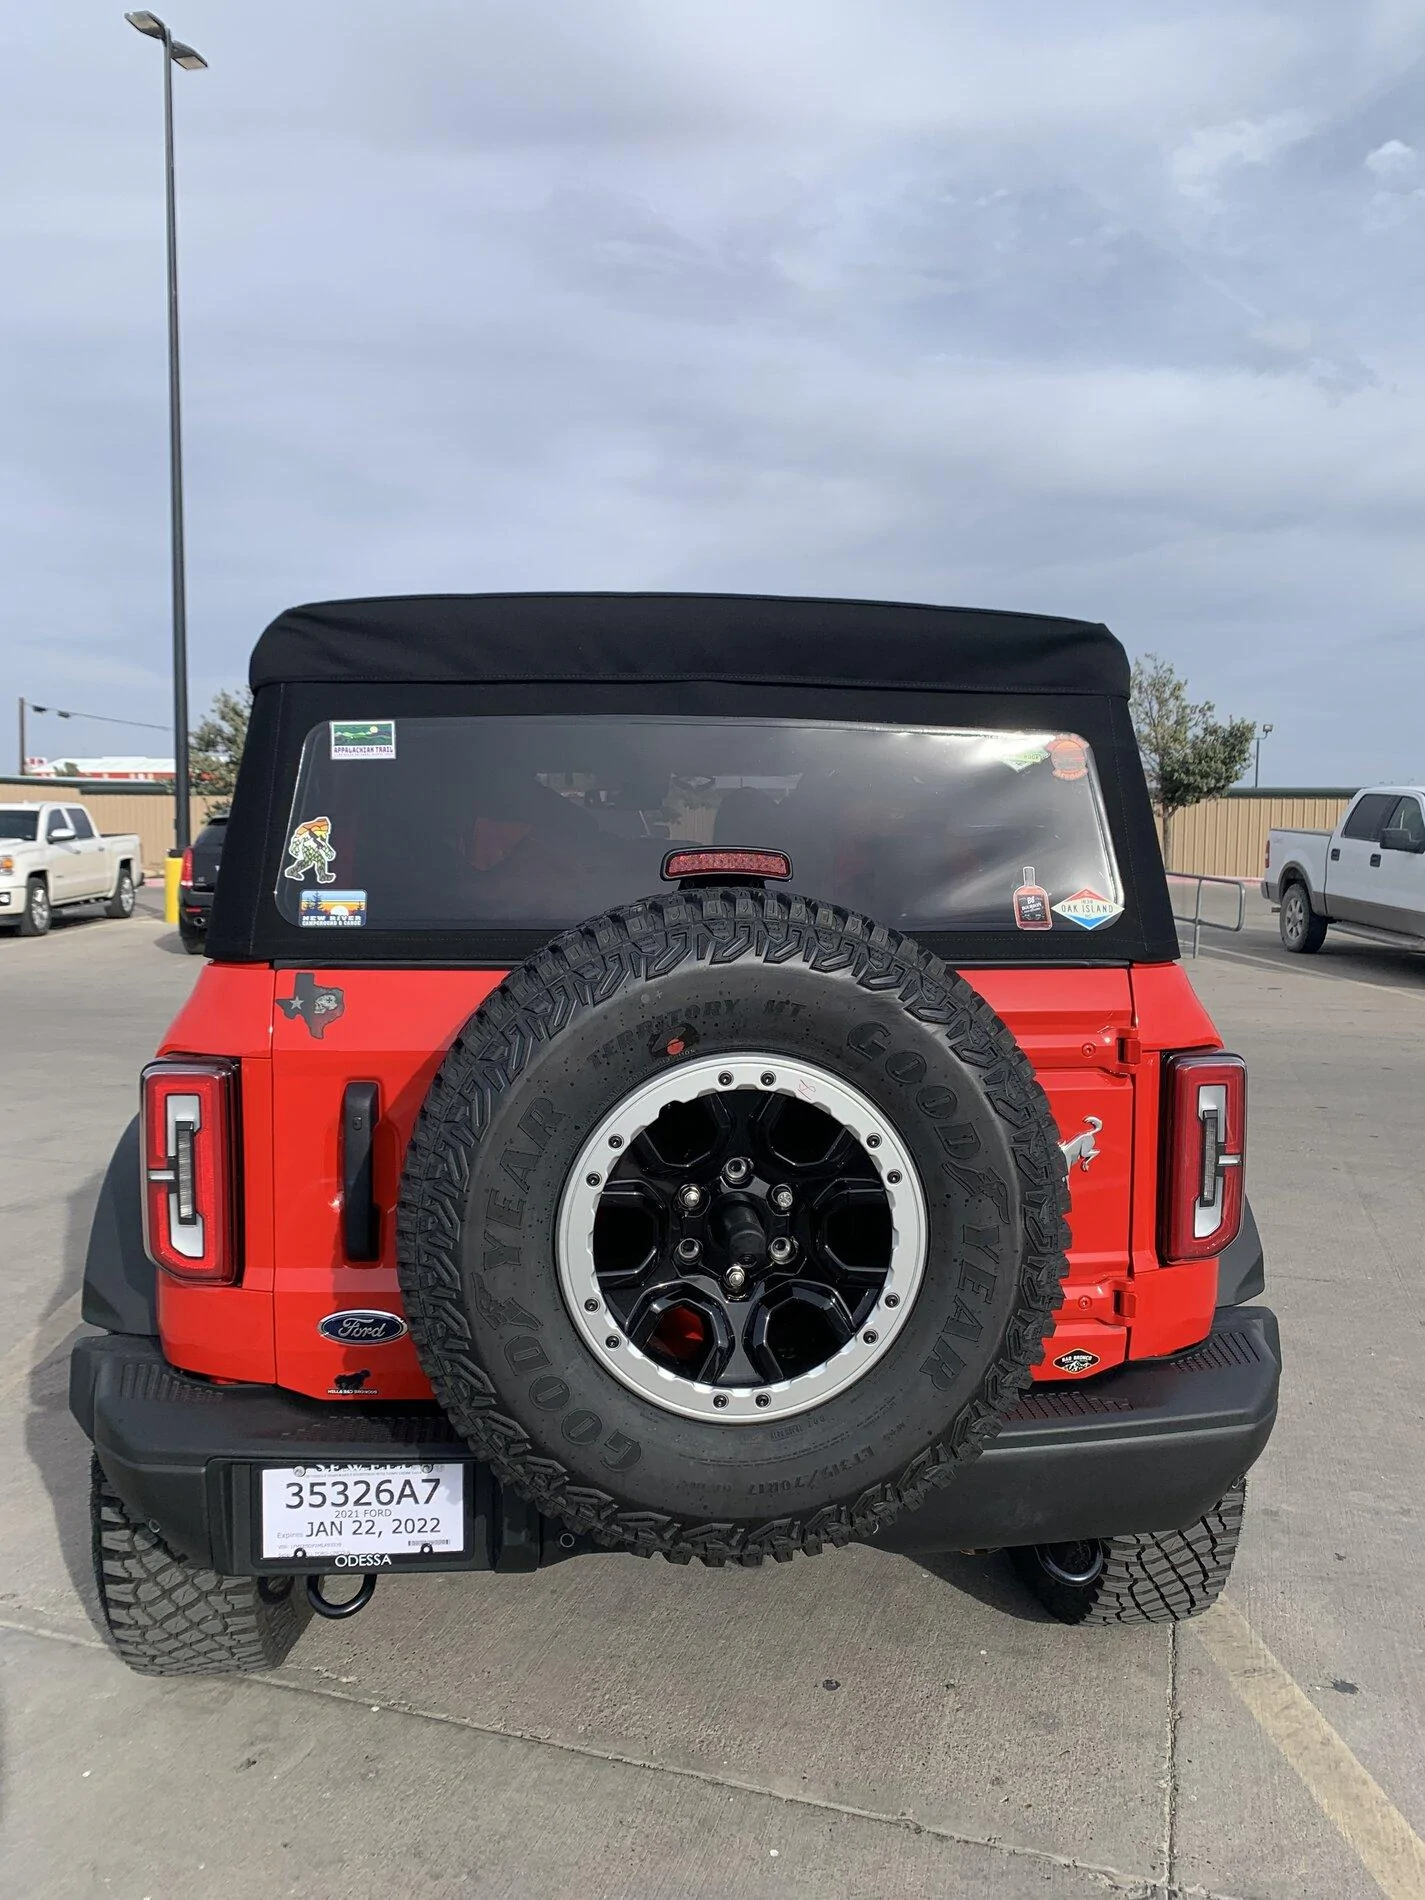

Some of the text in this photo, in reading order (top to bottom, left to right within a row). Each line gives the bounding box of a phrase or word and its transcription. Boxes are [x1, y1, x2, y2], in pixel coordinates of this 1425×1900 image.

[1061, 904, 1114, 913] OAK ISLAND
[338, 1317, 387, 1338] Ford
[285, 1478, 441, 1509] 35326A7
[334, 1508, 392, 1518] 2021 FORD
[305, 1520, 343, 1537] JAN
[352, 1519, 383, 1538] 22,
[391, 1517, 441, 1534] 2022
[334, 1554, 392, 1568] ODESSA
